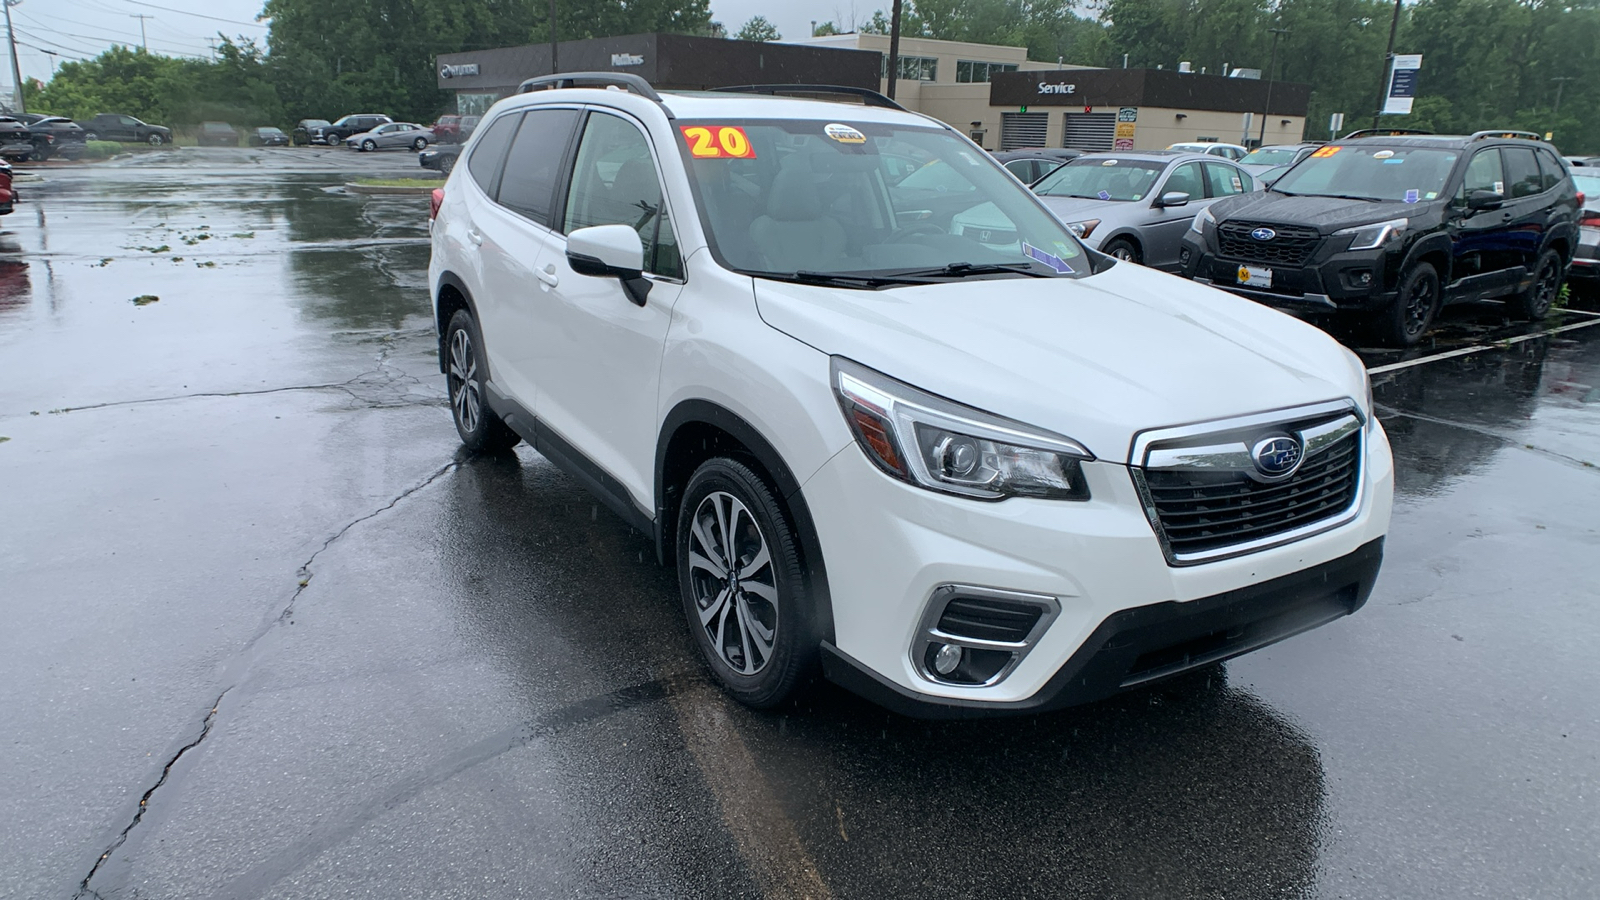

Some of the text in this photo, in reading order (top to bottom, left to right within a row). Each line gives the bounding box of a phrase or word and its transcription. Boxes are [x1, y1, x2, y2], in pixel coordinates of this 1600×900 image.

[1037, 81, 1076, 94] Service
[684, 127, 750, 157] 20
[1310, 146, 1342, 158] 23
